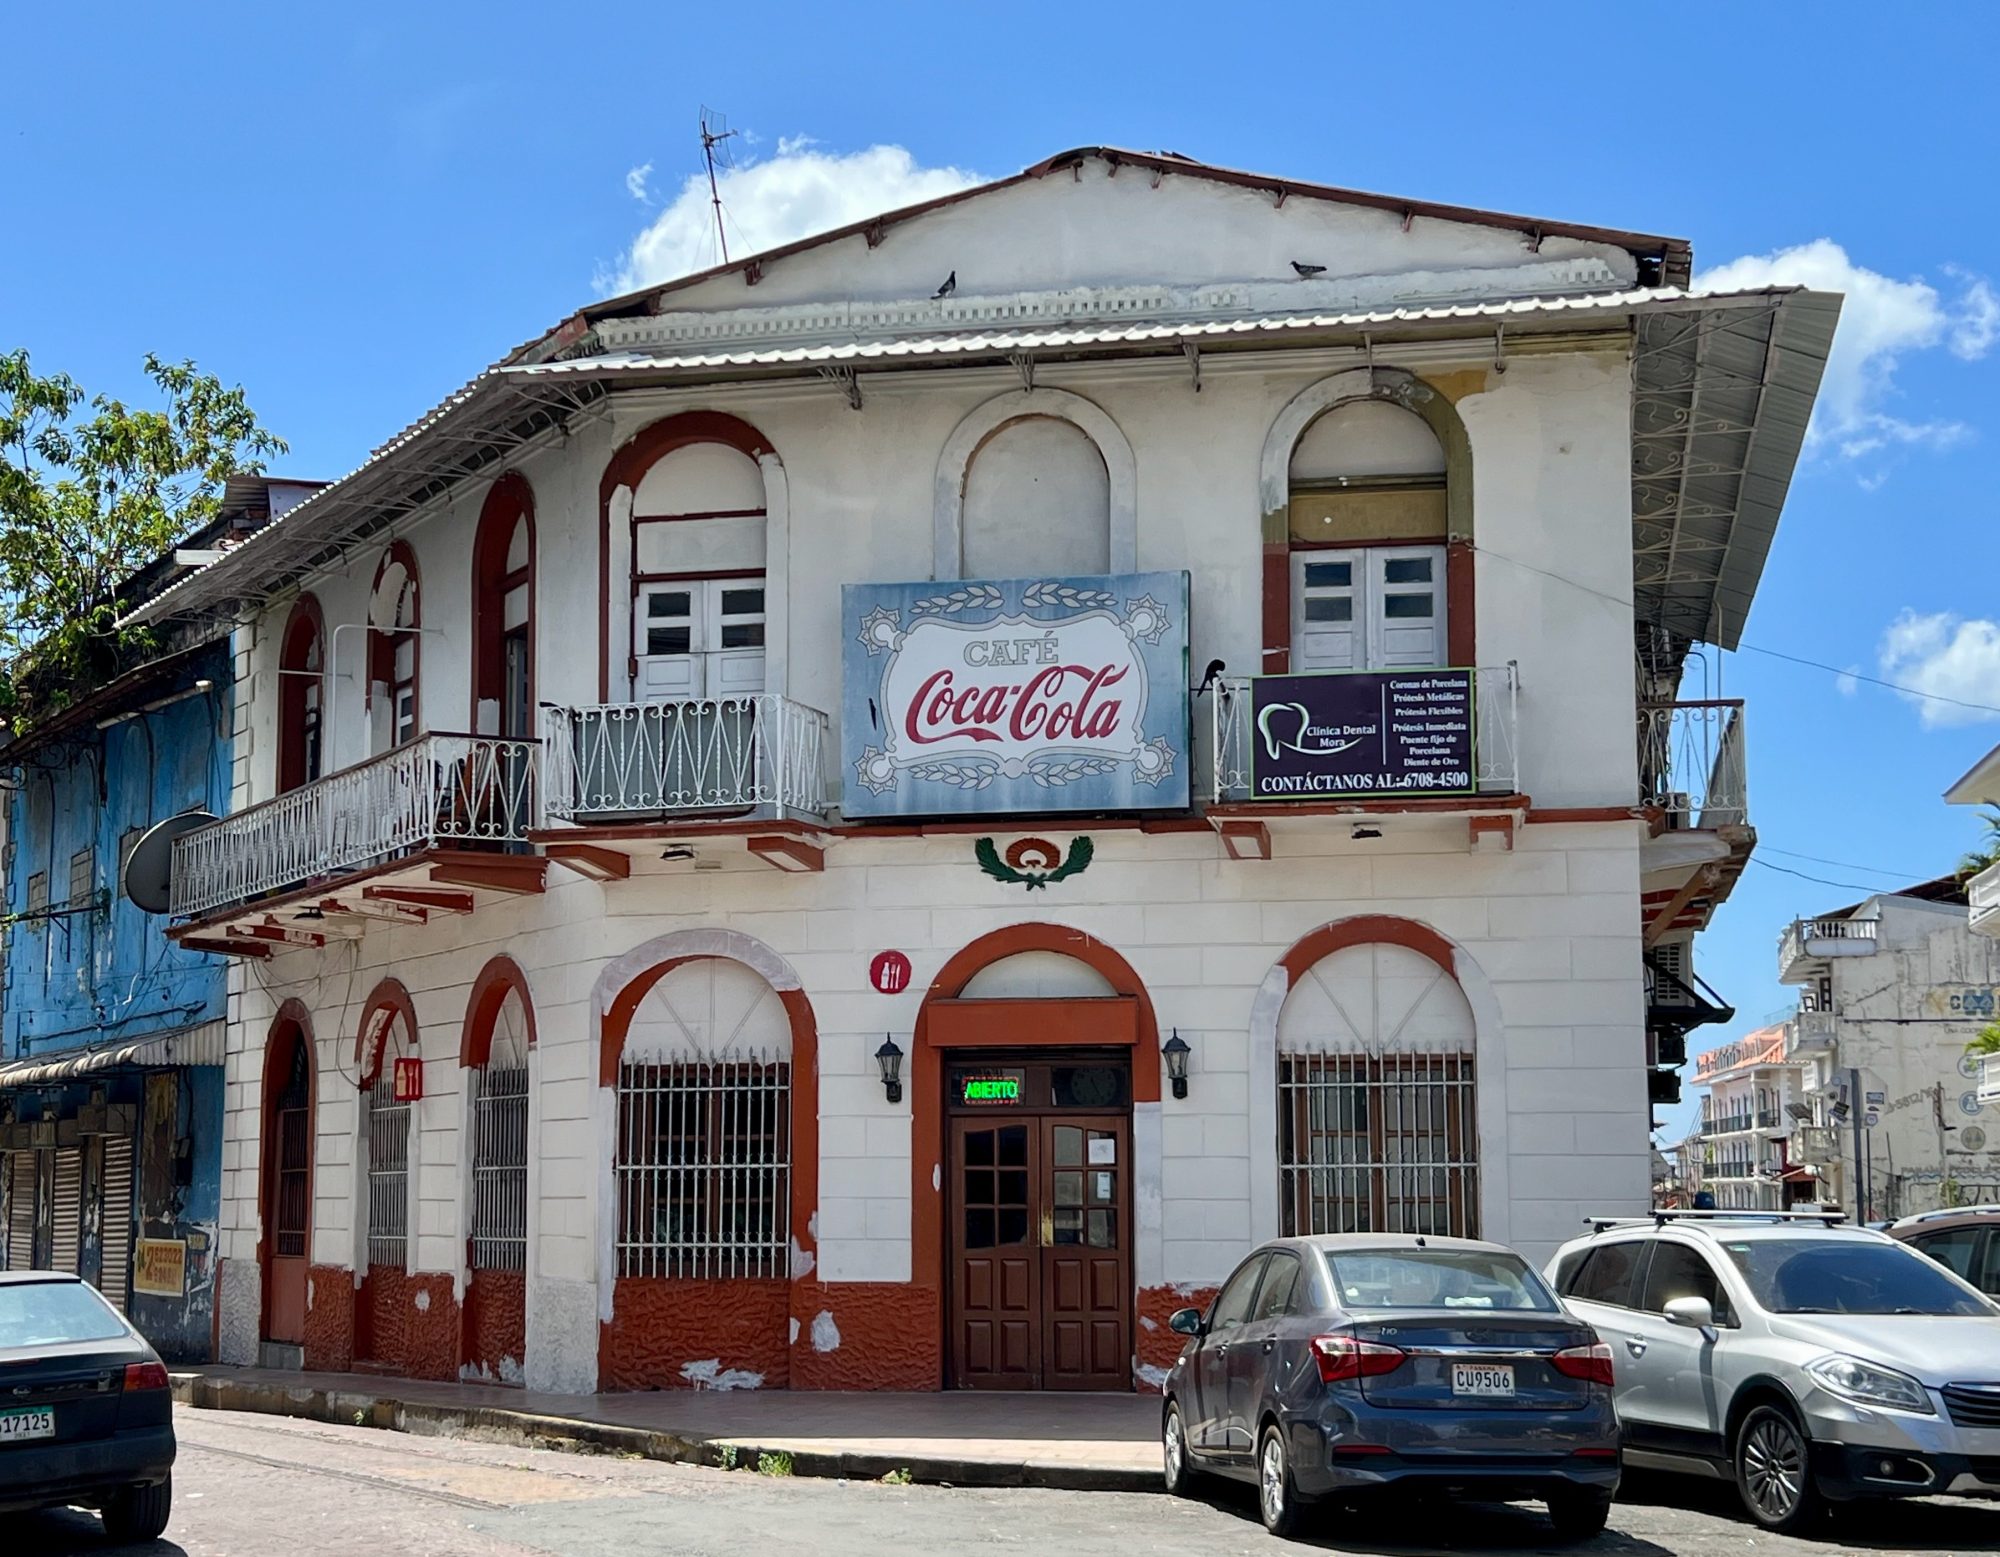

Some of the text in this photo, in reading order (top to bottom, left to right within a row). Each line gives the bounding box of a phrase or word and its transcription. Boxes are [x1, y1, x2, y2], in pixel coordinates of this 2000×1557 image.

[963, 630, 1059, 667] CAFÉ
[1389, 679, 1467, 689] Coronas de Porcelana
[904, 662, 1130, 744] Coca-Cola
[1428, 706, 1464, 715] Flexibles
[1306, 724, 1376, 737] Clínica Dental
[1320, 738, 1346, 747] Mora
[1400, 734, 1457, 744] Puente fijo de
[1409, 746, 1451, 755] Porcelana
[1403, 757, 1459, 766] Diente de Oro
[1261, 771, 1373, 792] CONTÁCTANOS
[964, 1081, 1018, 1099] ABIERTO
[1457, 1371, 1510, 1389] CU9506
